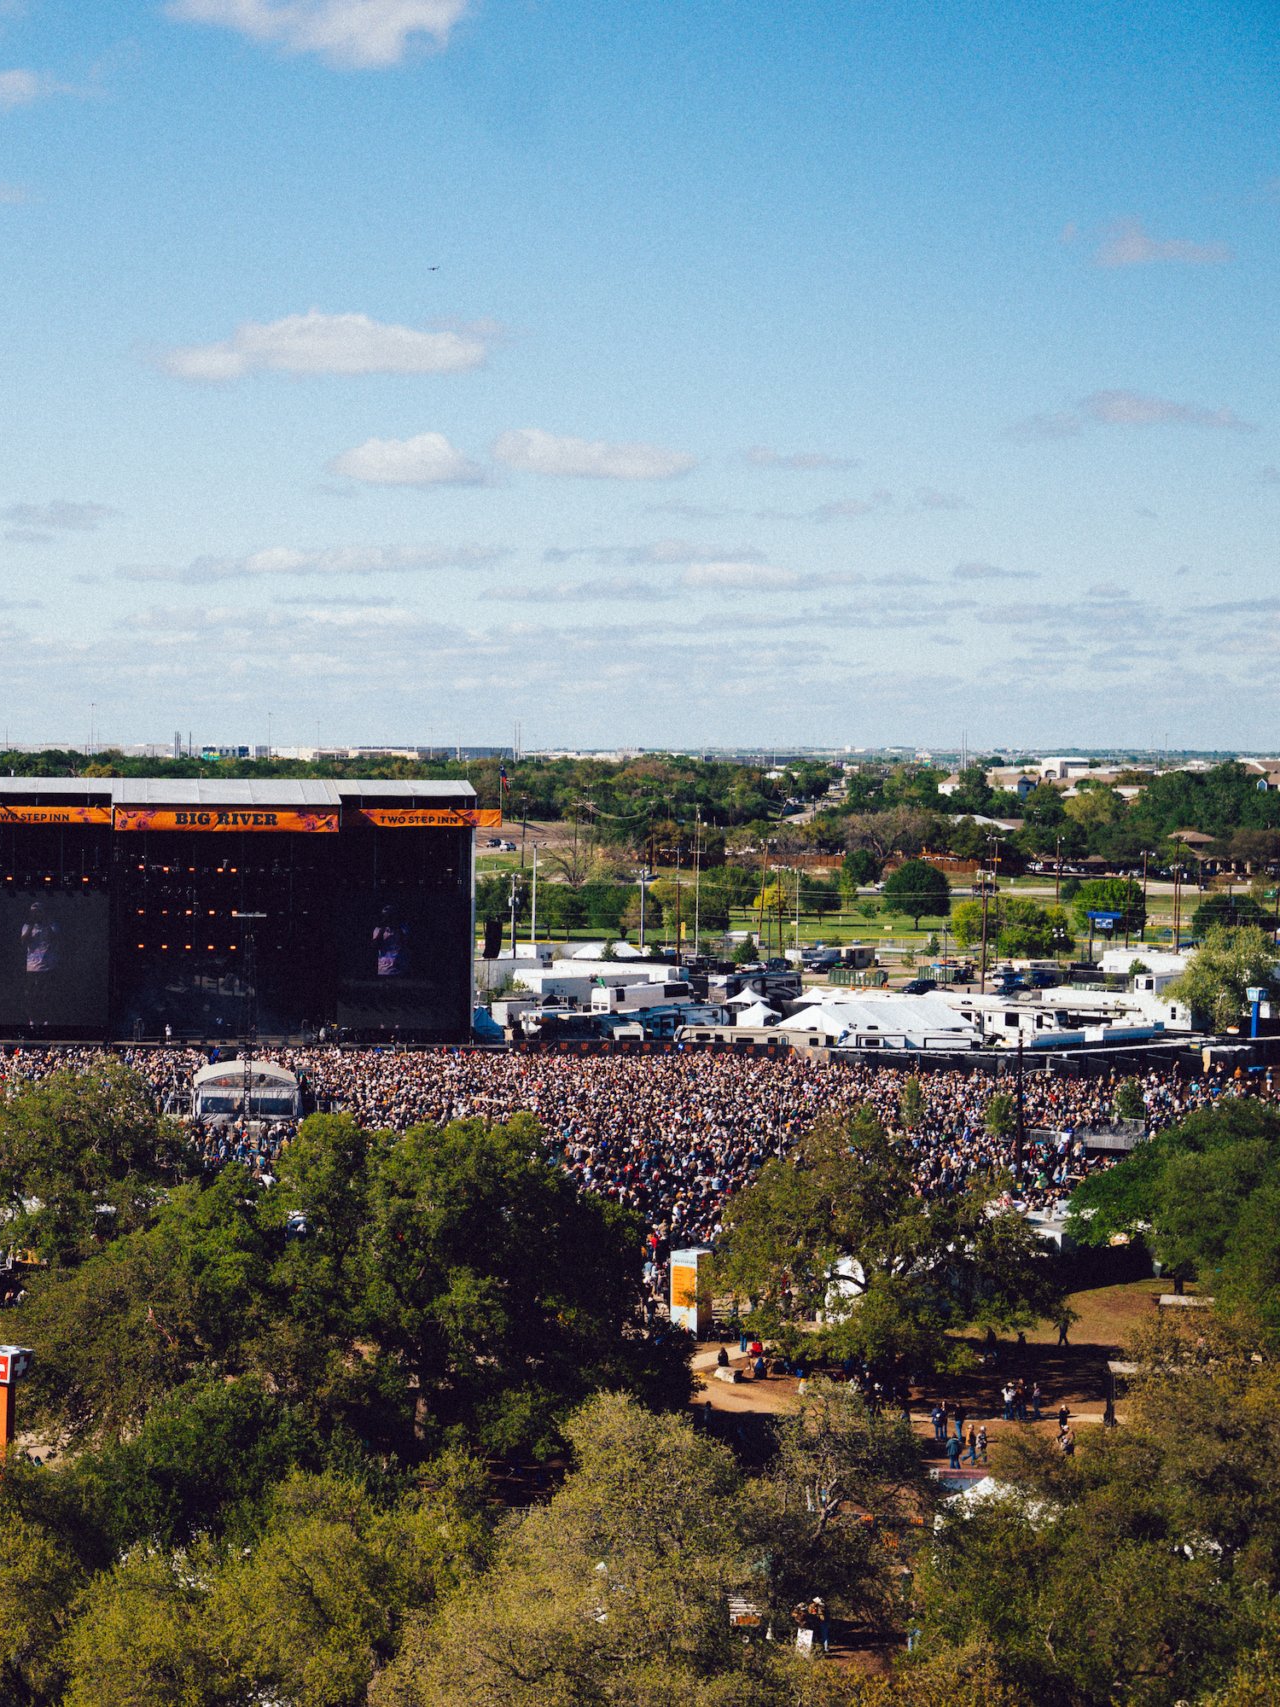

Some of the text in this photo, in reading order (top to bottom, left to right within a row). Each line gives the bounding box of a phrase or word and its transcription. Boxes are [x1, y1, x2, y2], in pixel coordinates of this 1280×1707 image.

[21, 813, 47, 822] STEP
[49, 814, 70, 822] INN
[175, 813, 278, 825] BIG RIVER
[380, 816, 458, 824] TWO STEP INN
